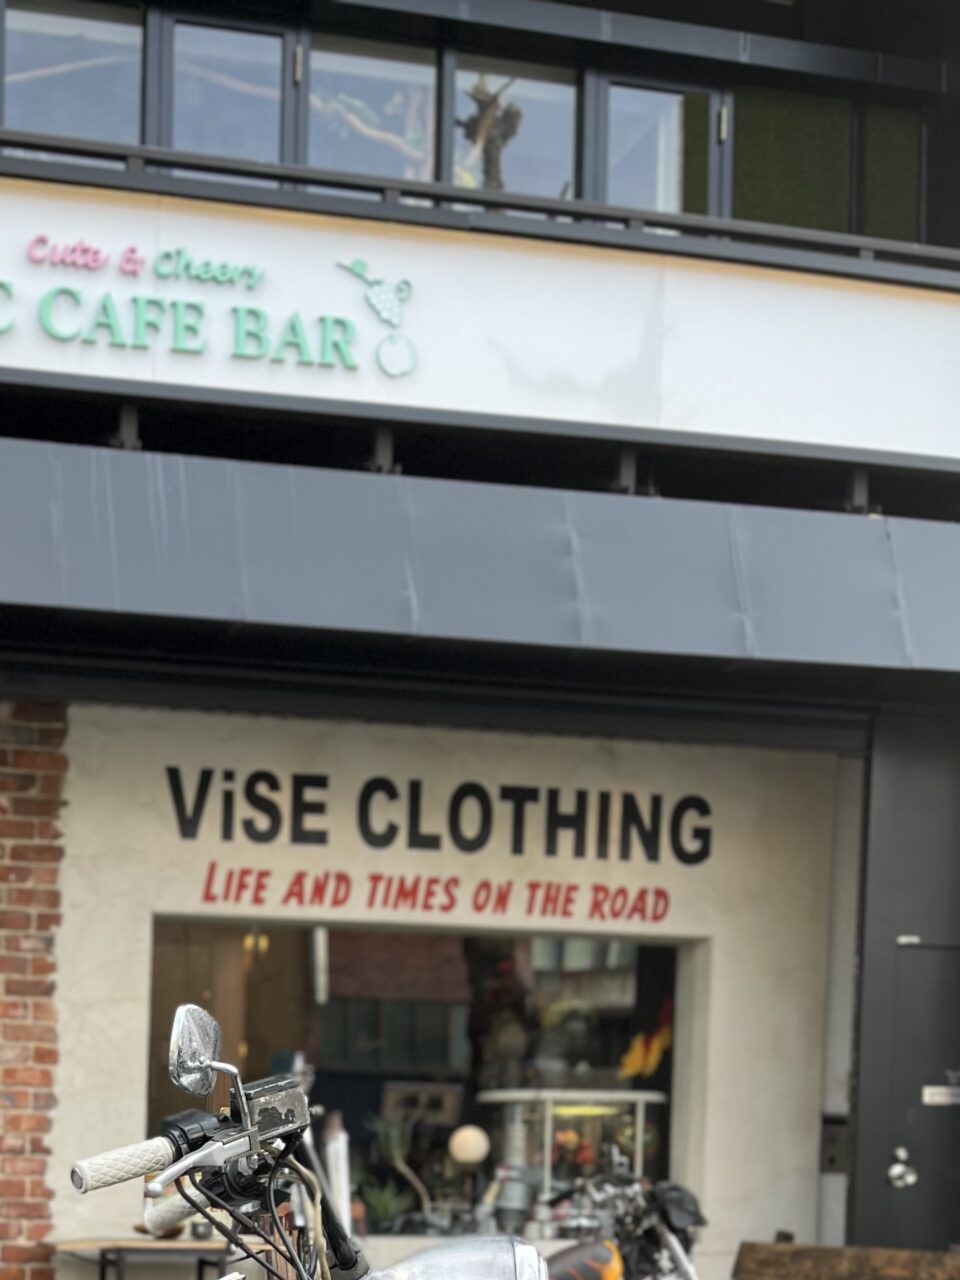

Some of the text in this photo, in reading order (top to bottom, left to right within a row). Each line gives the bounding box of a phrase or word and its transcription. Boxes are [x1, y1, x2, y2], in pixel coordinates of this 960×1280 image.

[26, 235, 265, 290] Cute & Cheery
[37, 286, 208, 354] CAFE
[231, 305, 359, 370] BAR
[357, 776, 713, 865] CLOTHING
[201, 861, 671, 923] LIFE AND TIMES ON THE ROAD
